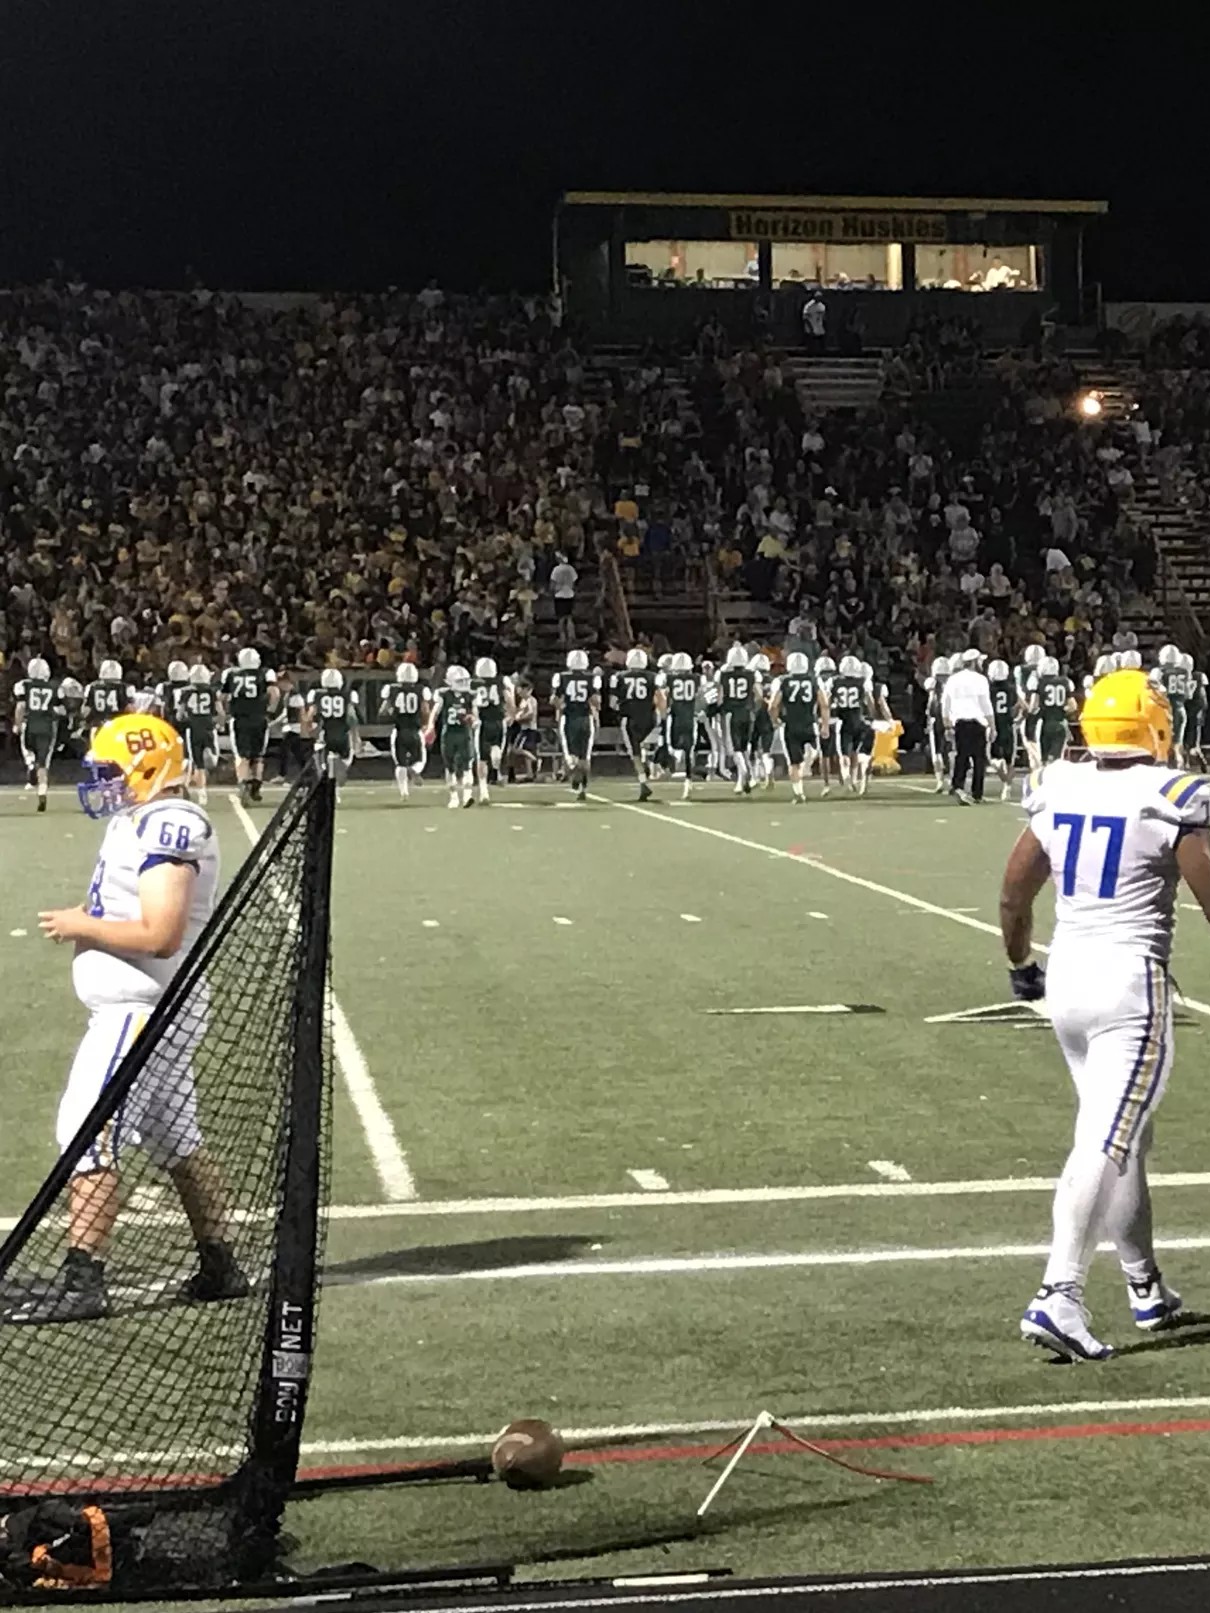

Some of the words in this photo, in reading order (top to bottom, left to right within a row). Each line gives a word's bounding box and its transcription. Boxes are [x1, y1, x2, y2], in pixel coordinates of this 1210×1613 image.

[736, 214, 833, 237] Horizon
[842, 215, 945, 238] Huskies
[233, 676, 257, 698] 75
[566, 680, 588, 702] 45
[624, 677, 648, 699] 76
[672, 679, 695, 701] 20
[728, 677, 748, 699] 12
[788, 680, 813, 702] 73
[836, 686, 860, 708] 32
[1044, 684, 1066, 707] 30
[29, 687, 53, 711] 67
[94, 689, 119, 712] 64
[187, 692, 211, 715] 42
[320, 696, 345, 718] 99
[394, 692, 418, 714] 40
[995, 691, 1008, 714] 2
[125, 729, 156, 754] 68
[159, 821, 191, 851] 68
[1053, 812, 1127, 899] 77
[281, 1301, 303, 1350] NET
